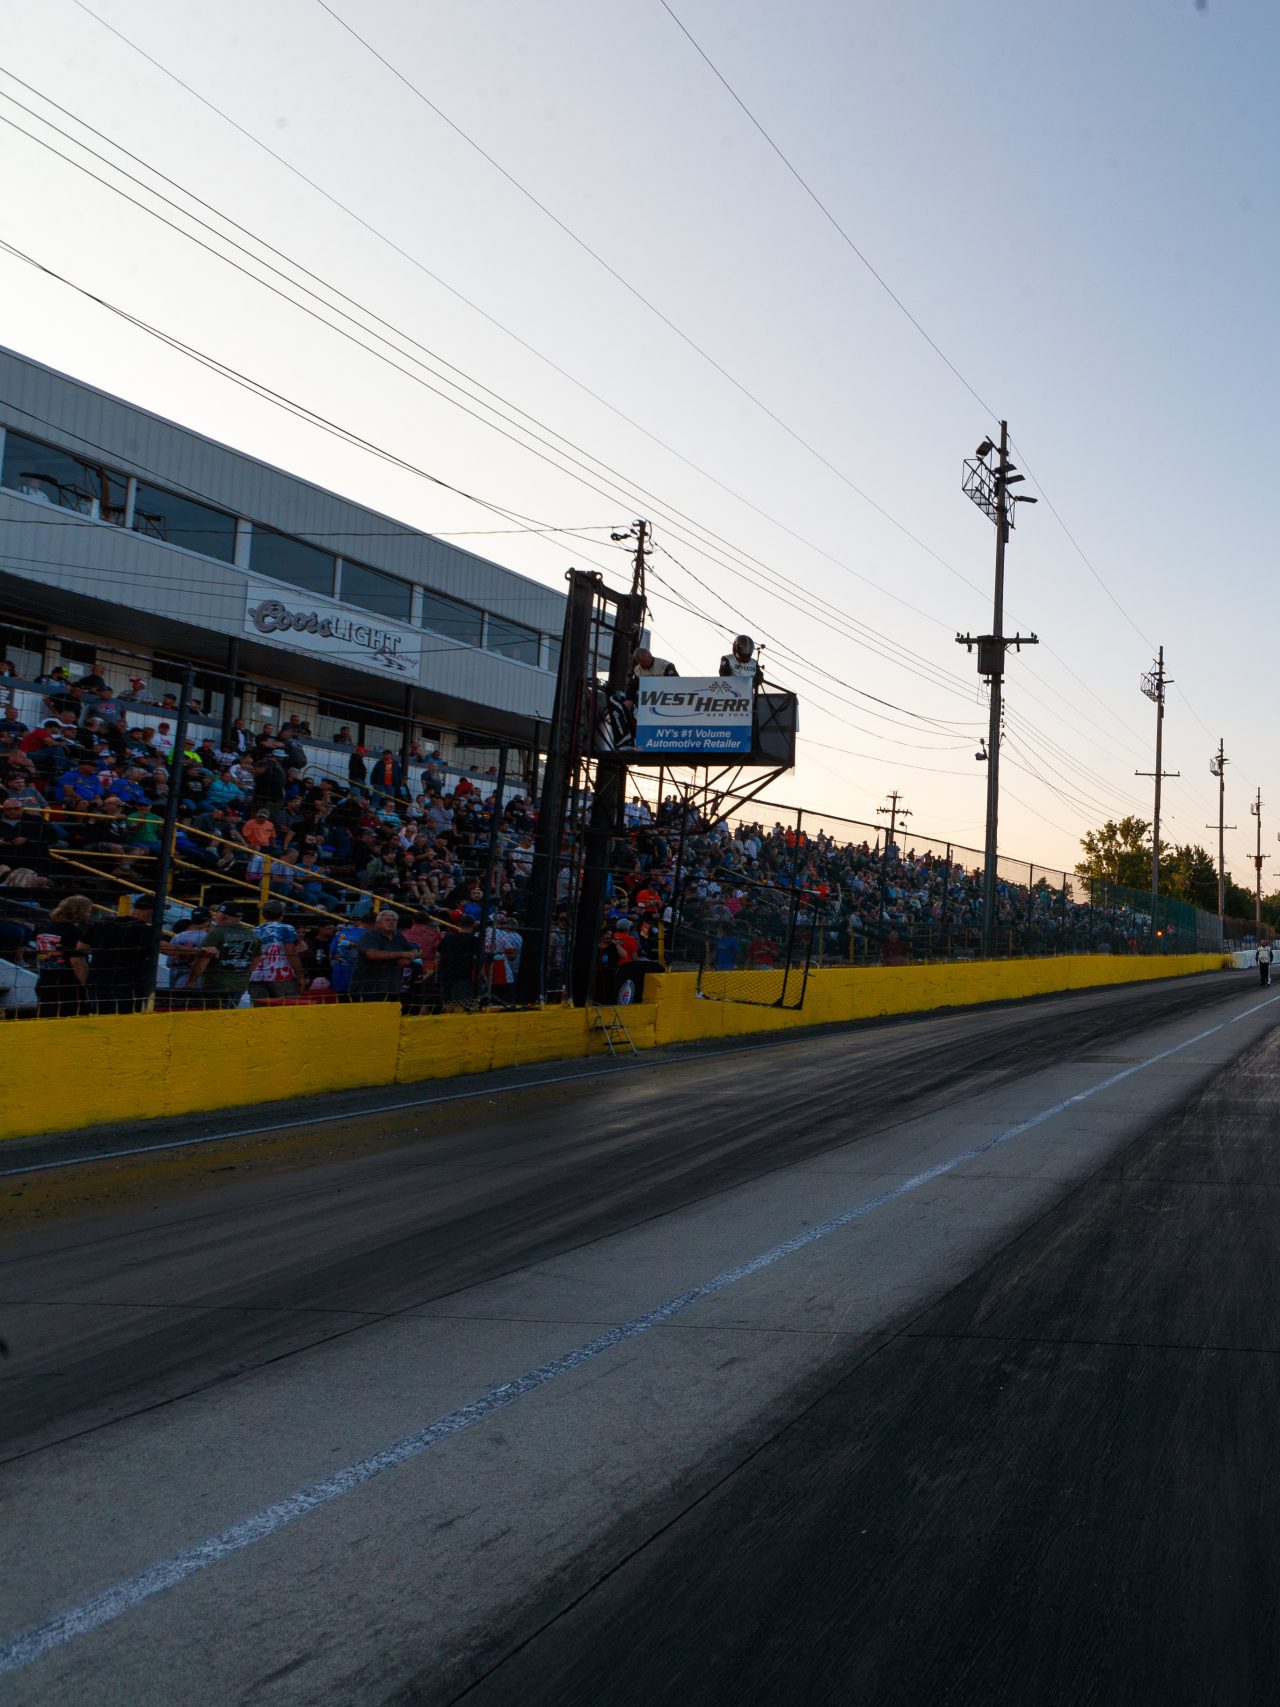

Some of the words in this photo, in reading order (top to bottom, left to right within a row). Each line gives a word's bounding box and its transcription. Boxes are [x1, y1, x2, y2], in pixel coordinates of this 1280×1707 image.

[248, 599, 332, 638] Coors
[330, 615, 402, 654] LIGHT
[640, 690, 698, 706] WEST
[694, 699, 750, 712] HERR
[656, 729, 679, 738] NY's
[681, 729, 692, 738] #1
[695, 729, 732, 738] Volume
[646, 739, 701, 748] Automotive
[703, 739, 742, 748] Retailer
